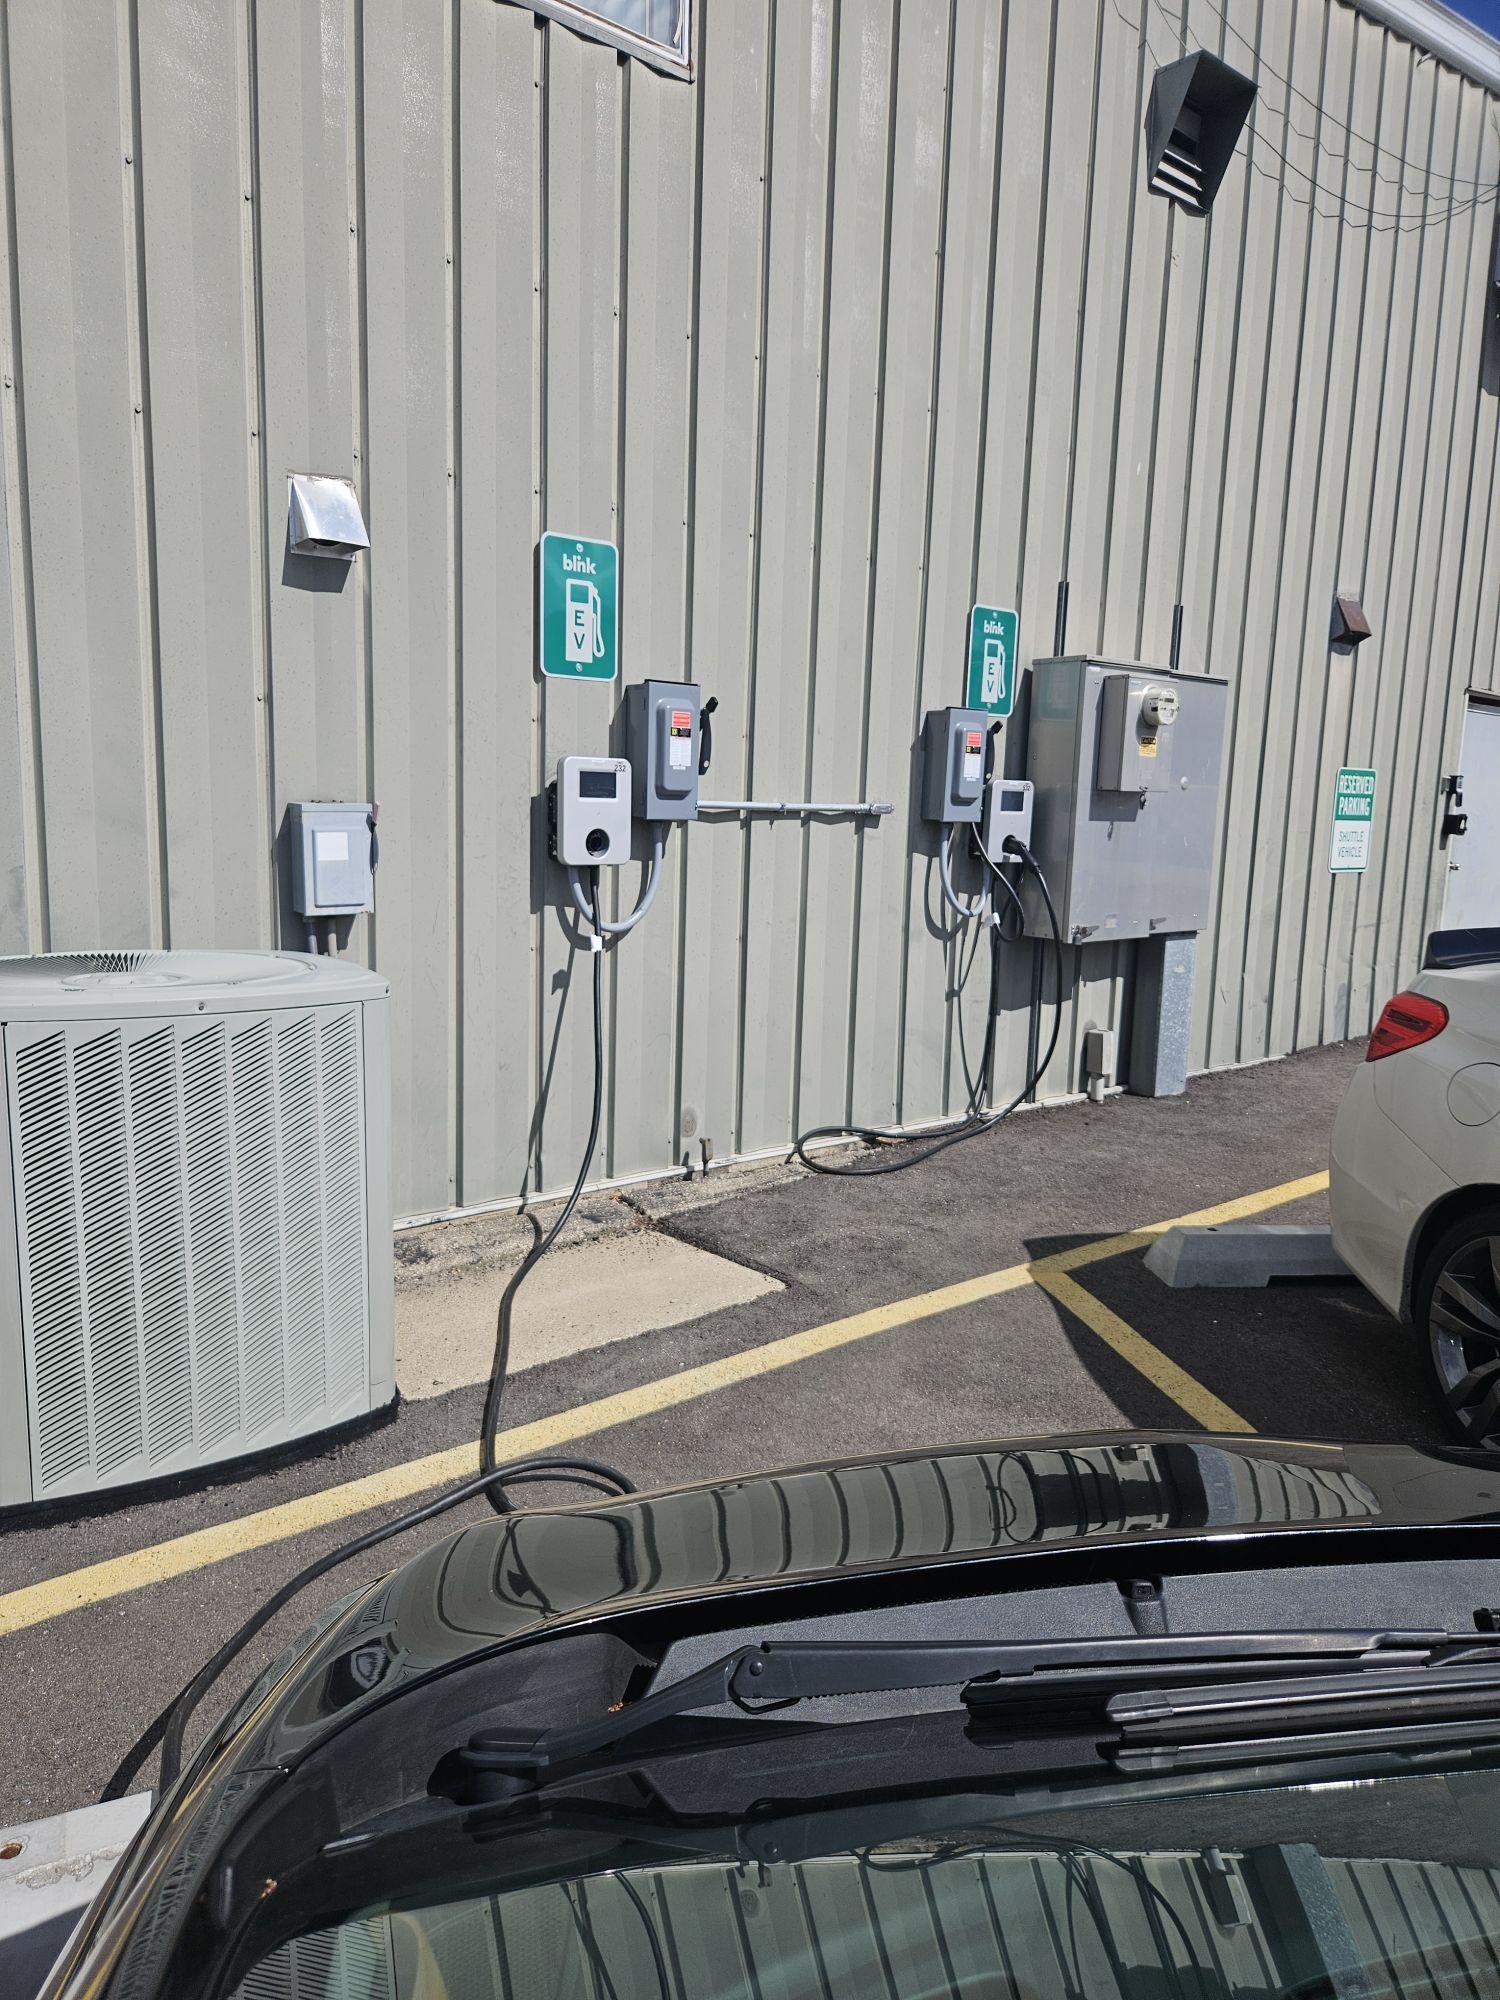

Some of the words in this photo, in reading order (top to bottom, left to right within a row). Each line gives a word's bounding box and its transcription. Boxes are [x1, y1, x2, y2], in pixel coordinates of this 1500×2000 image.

[562, 553, 597, 575] blink
[983, 619, 1004, 635] blink
[614, 764, 626, 772] 232
[1338, 774, 1375, 795] RESERVED
[1338, 796, 1372, 816] PARKING
[1339, 831, 1364, 842] SHUTTLE
